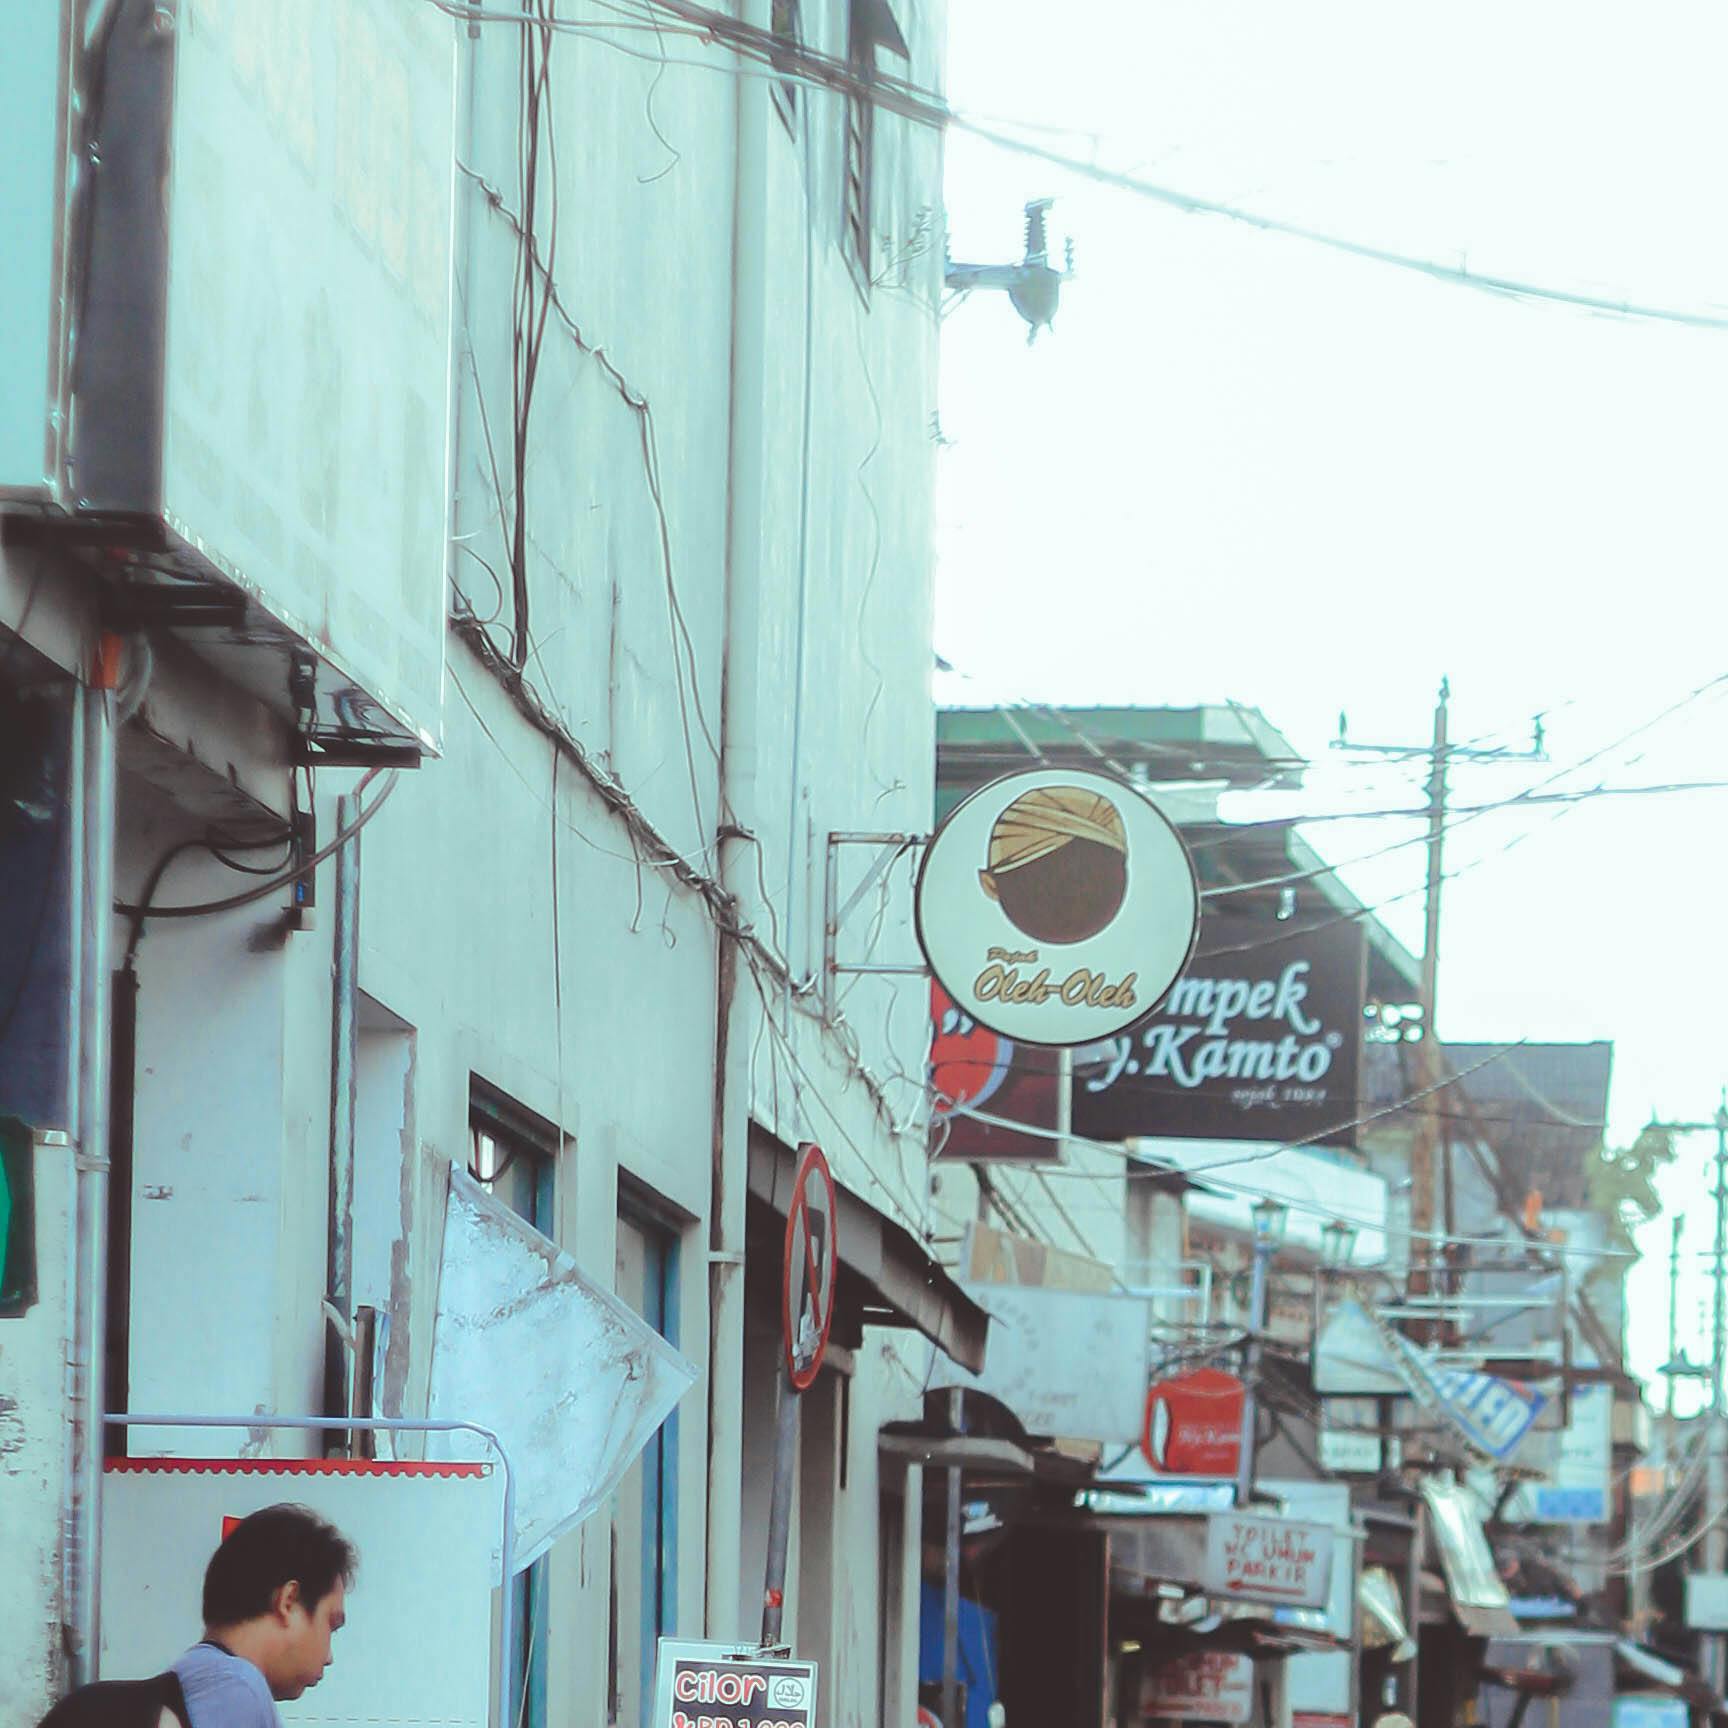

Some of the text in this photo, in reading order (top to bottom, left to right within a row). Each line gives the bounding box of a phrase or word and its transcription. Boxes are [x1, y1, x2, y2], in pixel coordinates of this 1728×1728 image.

[974, 964, 1138, 1008] Oleh-Oleh
[1165, 960, 1321, 1036] mpek
[676, 1670, 767, 1706] Cilor
